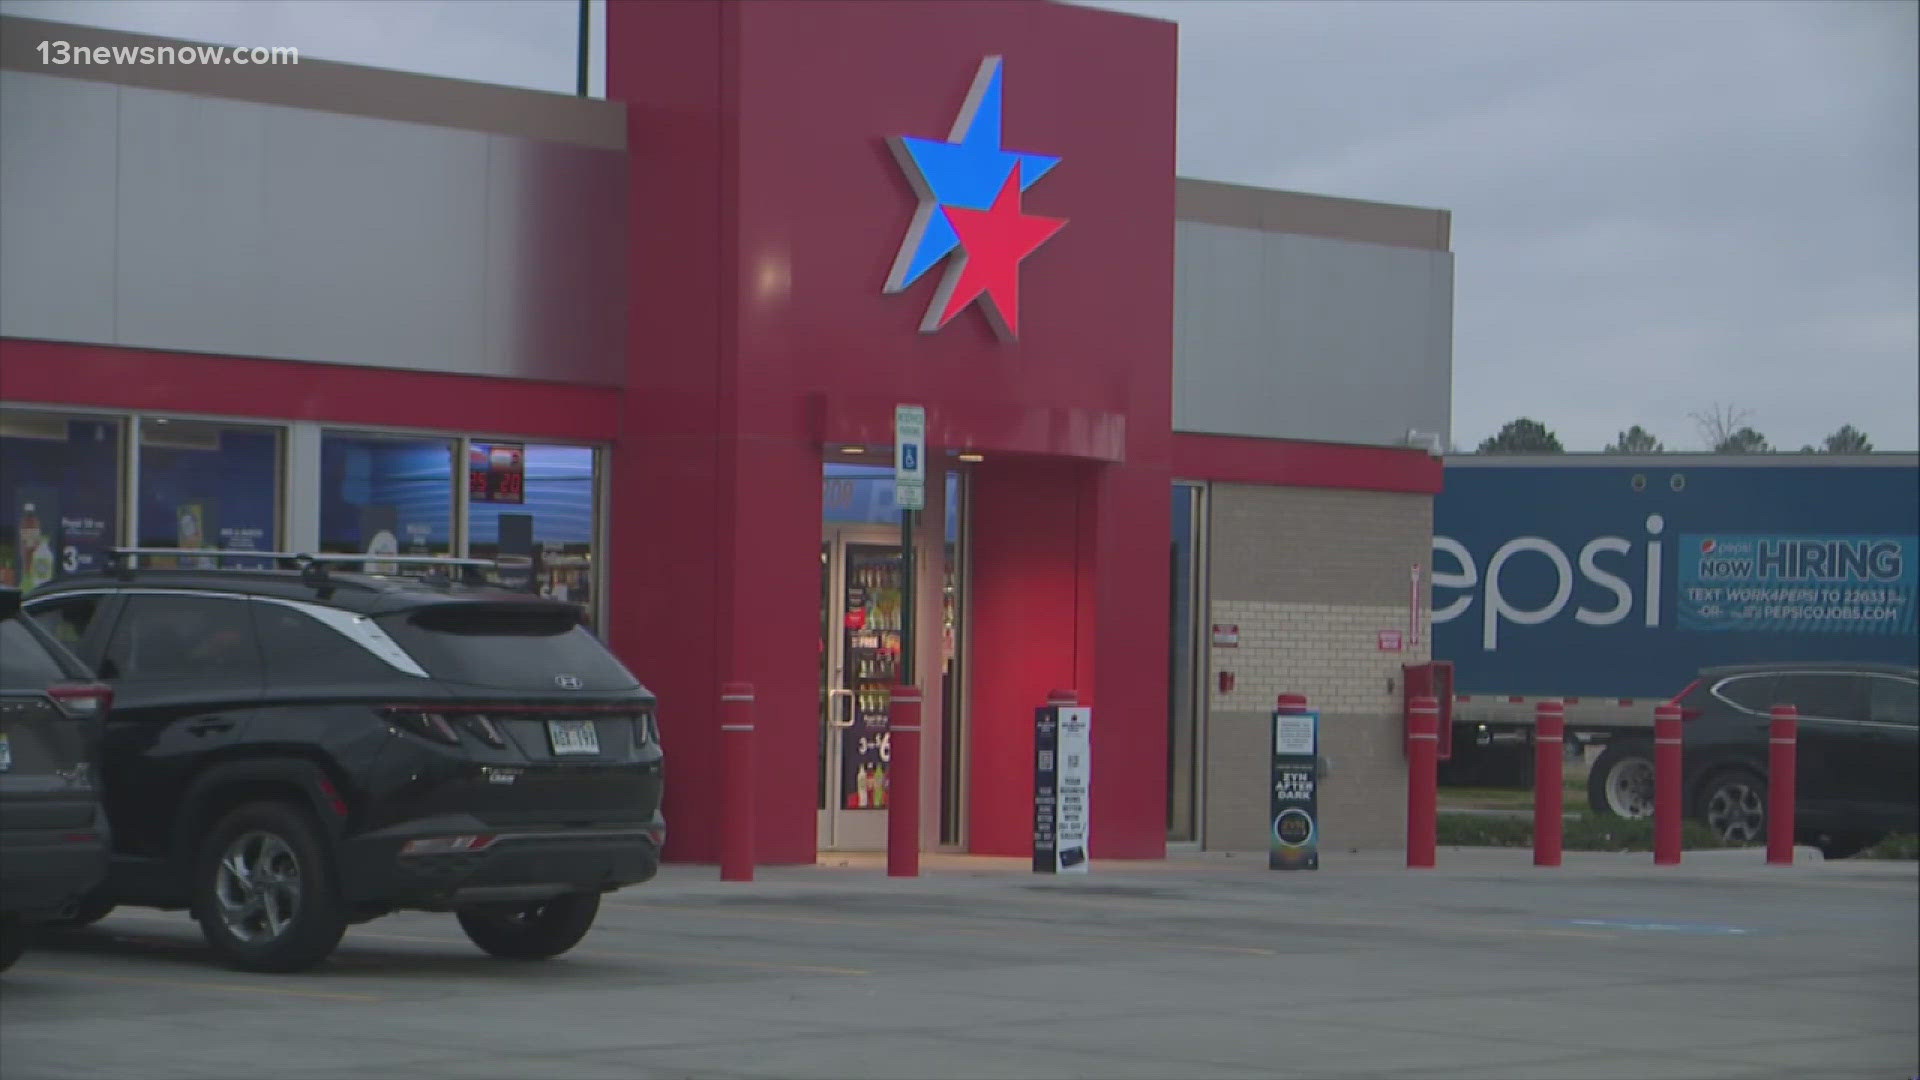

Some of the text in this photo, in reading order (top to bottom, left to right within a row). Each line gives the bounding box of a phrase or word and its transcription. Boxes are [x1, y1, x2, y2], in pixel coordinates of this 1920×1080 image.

[62, 545, 79, 572] 3
[1700, 539, 1902, 582] NOW HIRING
[1431, 514, 1664, 651] epsi
[1688, 588, 1721, 601] TEXT
[1726, 588, 1819, 602] WORK4PEPSI
[1821, 590, 1840, 602] TO
[1764, 606, 1897, 620] PEPSICOJOBS.COM
[1282, 772, 1308, 782] ZYN
[1275, 781, 1314, 792] AFTER
[1278, 790, 1311, 800] DARK
